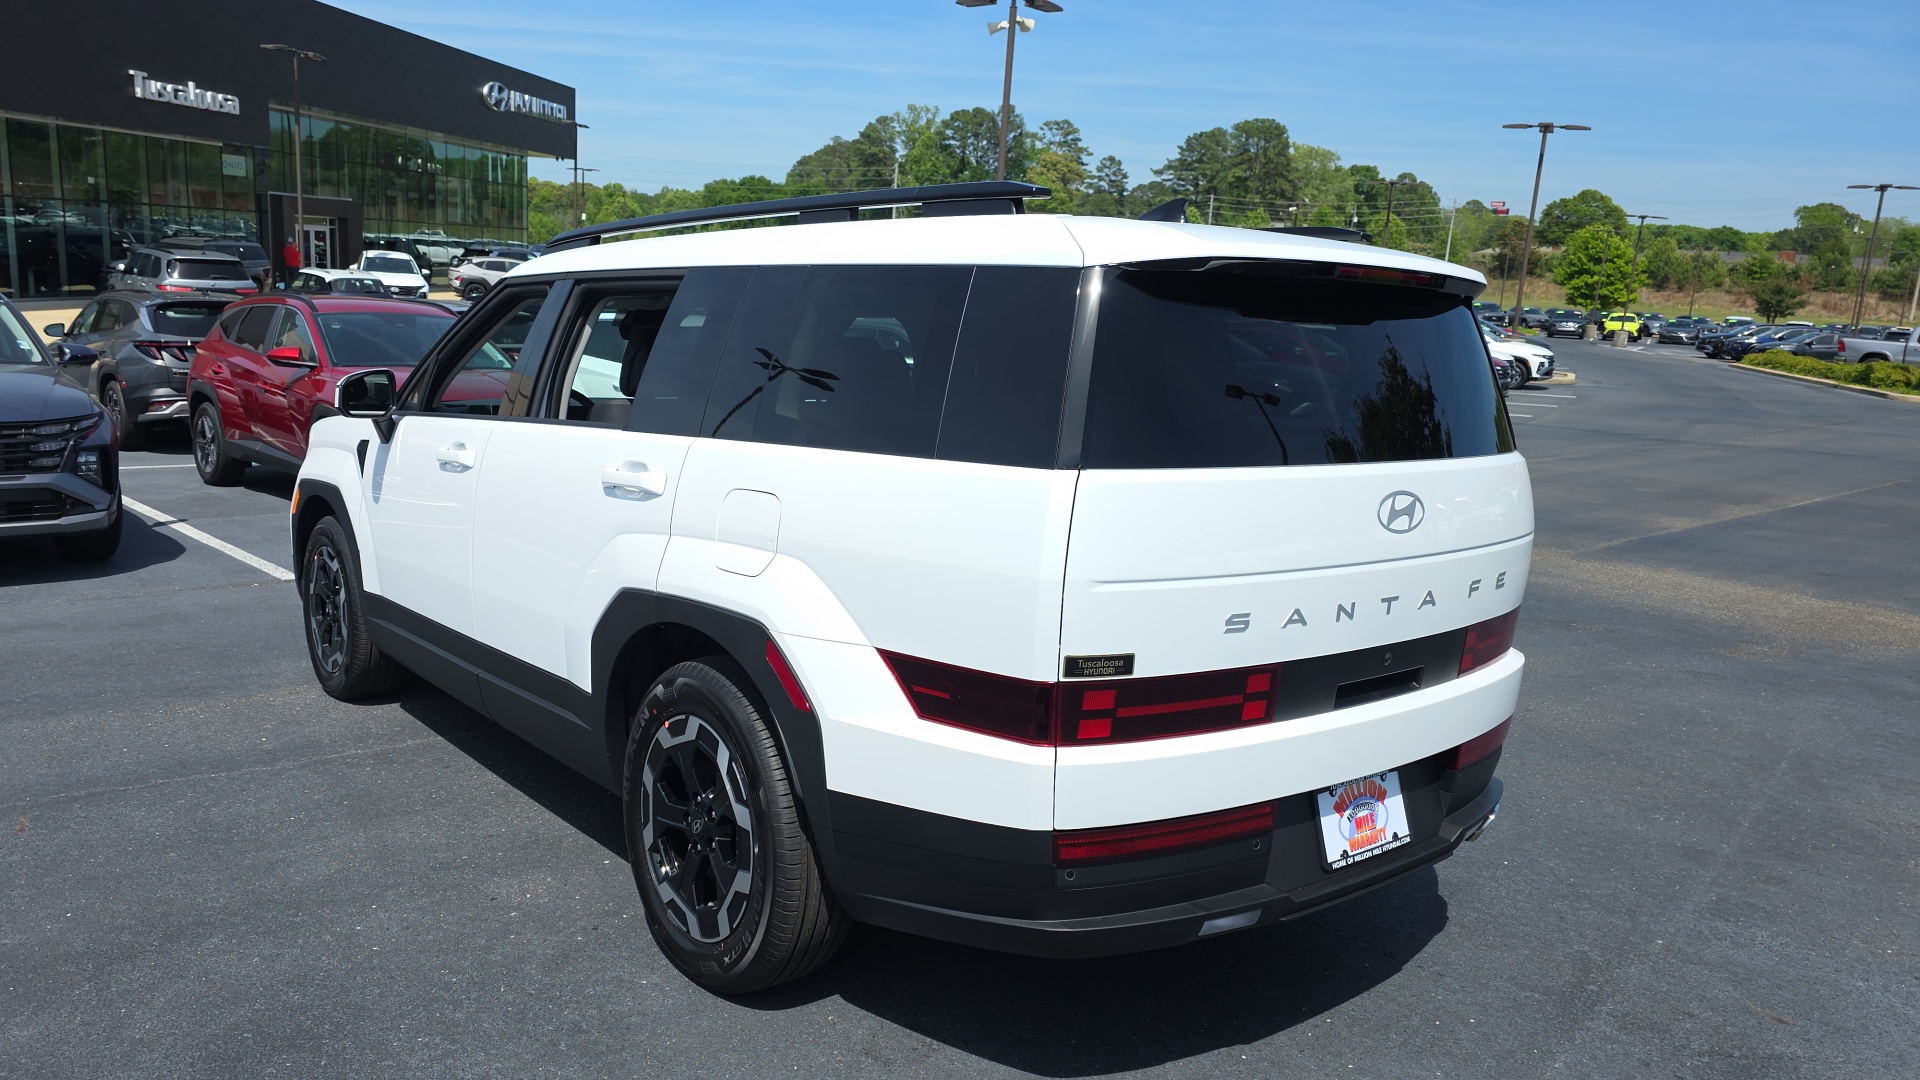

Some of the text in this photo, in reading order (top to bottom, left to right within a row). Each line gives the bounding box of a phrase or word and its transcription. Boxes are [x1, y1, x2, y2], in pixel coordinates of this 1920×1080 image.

[128, 69, 241, 116] Tuscaloosa
[510, 90, 568, 123] HYUNDAI
[1222, 570, 1507, 635] SANTA FE
[1077, 658, 1124, 668] Tuscaloosa
[1083, 667, 1116, 676] HYUNDAI
[623, 705, 650, 802] NEXEN
[1332, 779, 1388, 819] MILLION
[1347, 827, 1387, 853] WARRANTY
[1354, 811, 1376, 835] MILE
[1331, 835, 1411, 870] HOME OF MILLION MILE HYUNDAI.COM
